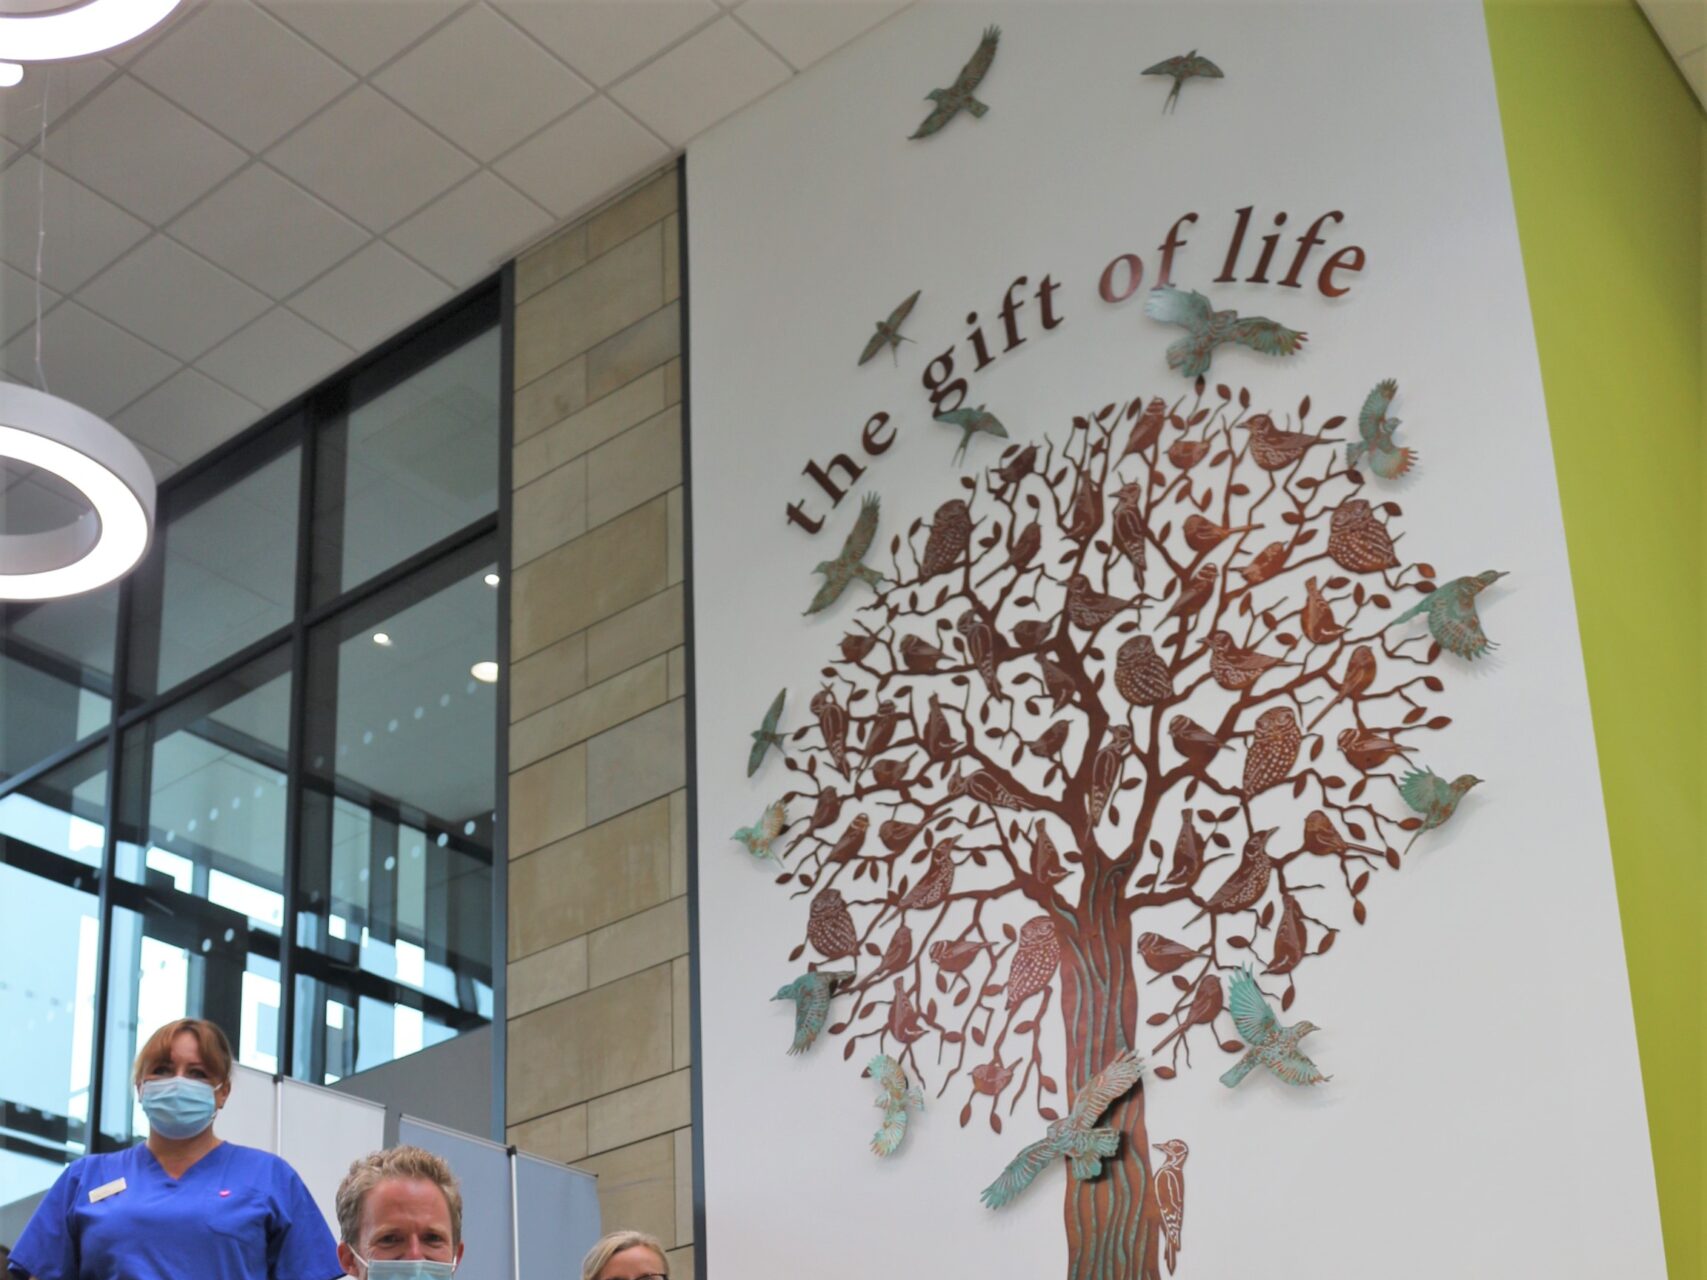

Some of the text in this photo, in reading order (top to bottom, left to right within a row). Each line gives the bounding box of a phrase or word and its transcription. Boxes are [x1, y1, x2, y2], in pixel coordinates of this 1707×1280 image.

[787, 205, 1367, 536] the gift of life
